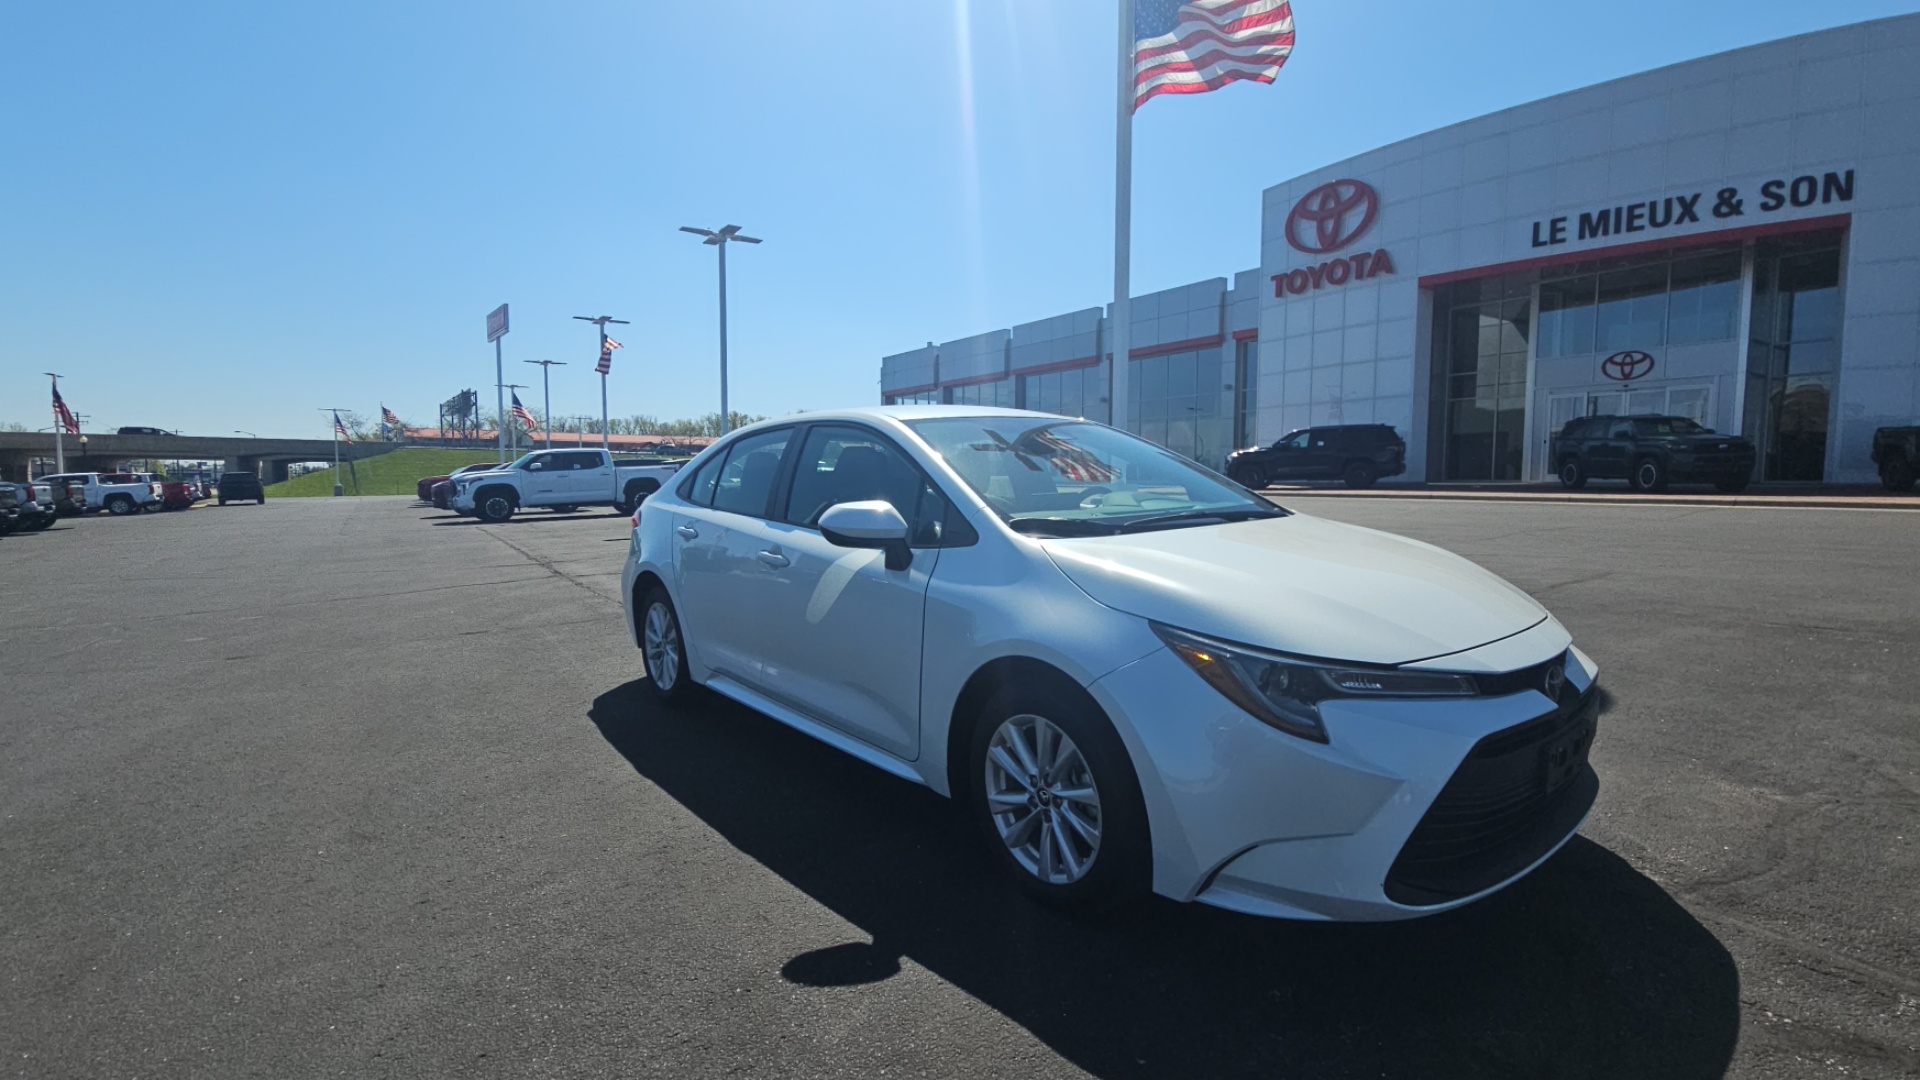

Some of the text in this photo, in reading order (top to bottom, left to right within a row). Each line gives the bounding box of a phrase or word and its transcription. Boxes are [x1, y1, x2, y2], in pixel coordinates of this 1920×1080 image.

[1532, 169, 1854, 248] LE MIEUX & SON
[1270, 248, 1394, 298] TOYOTA
